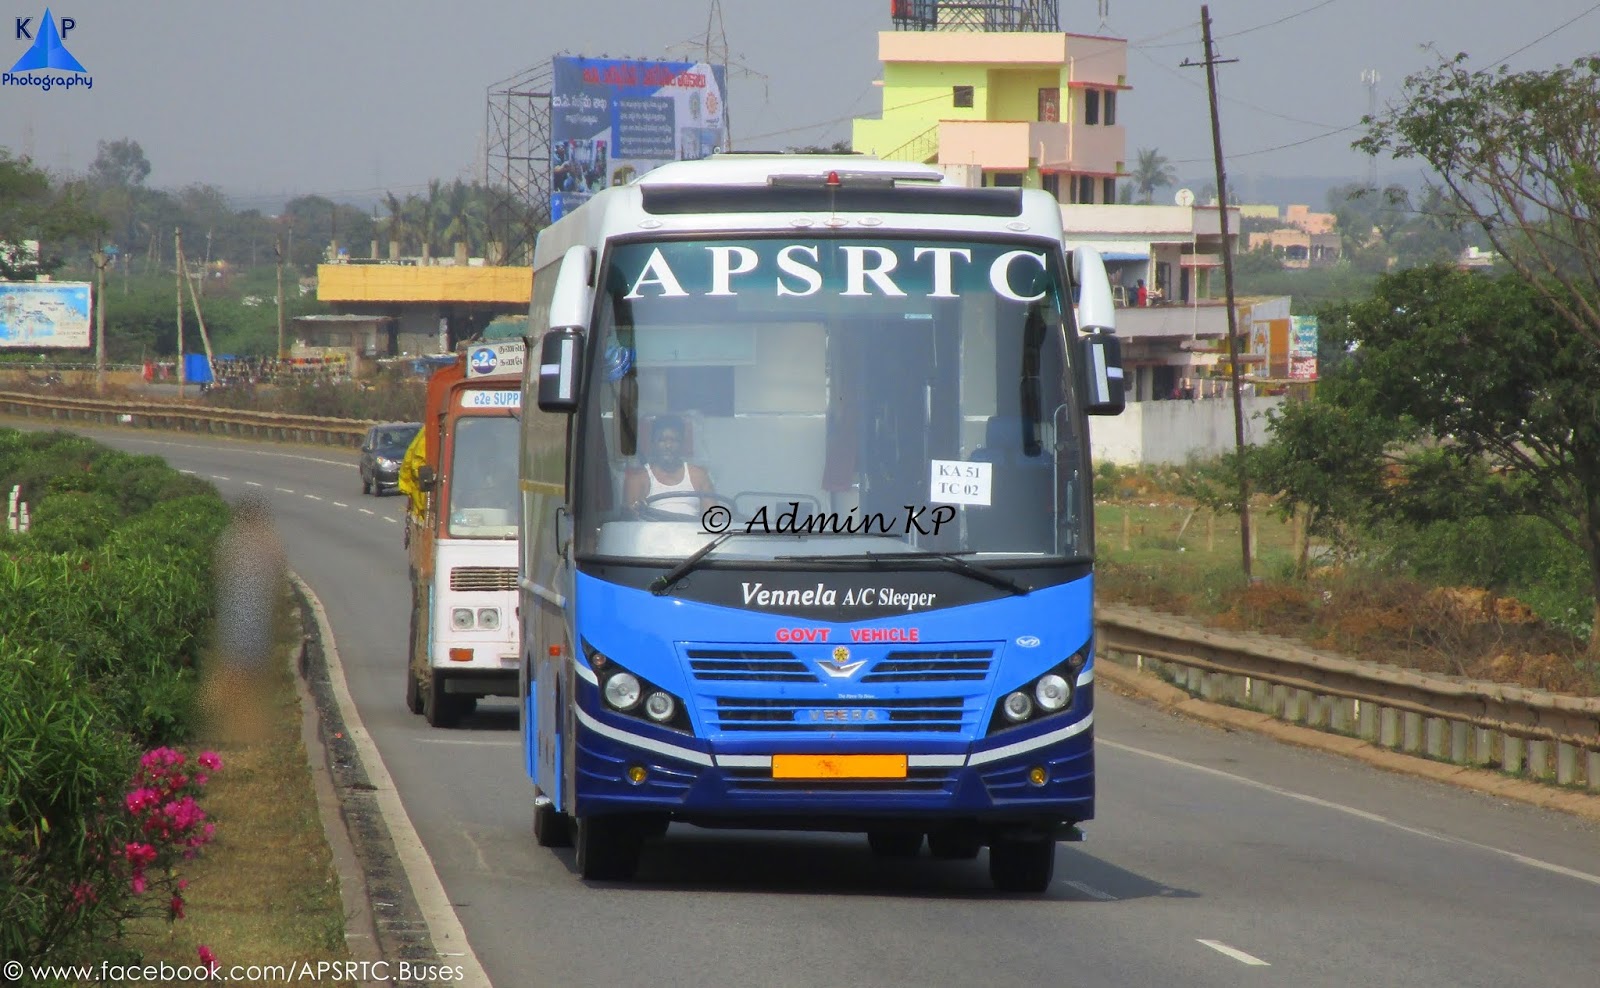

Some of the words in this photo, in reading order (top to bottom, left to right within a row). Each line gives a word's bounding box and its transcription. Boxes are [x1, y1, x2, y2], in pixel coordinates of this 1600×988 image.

[623, 244, 1048, 302] APSRTC
[474, 393, 491, 405] e2e
[494, 393, 521, 405] SUPP
[939, 464, 961, 477] KA
[966, 466, 980, 479] 51
[938, 482, 960, 495] TC
[963, 484, 979, 496] 02
[741, 582, 836, 605] Vennela
[842, 588, 876, 606] A/C
[878, 588, 936, 610] Sleeper
[775, 628, 831, 643] GOVT
[850, 628, 920, 643] VEHICLE
[808, 709, 878, 721] VEERA
